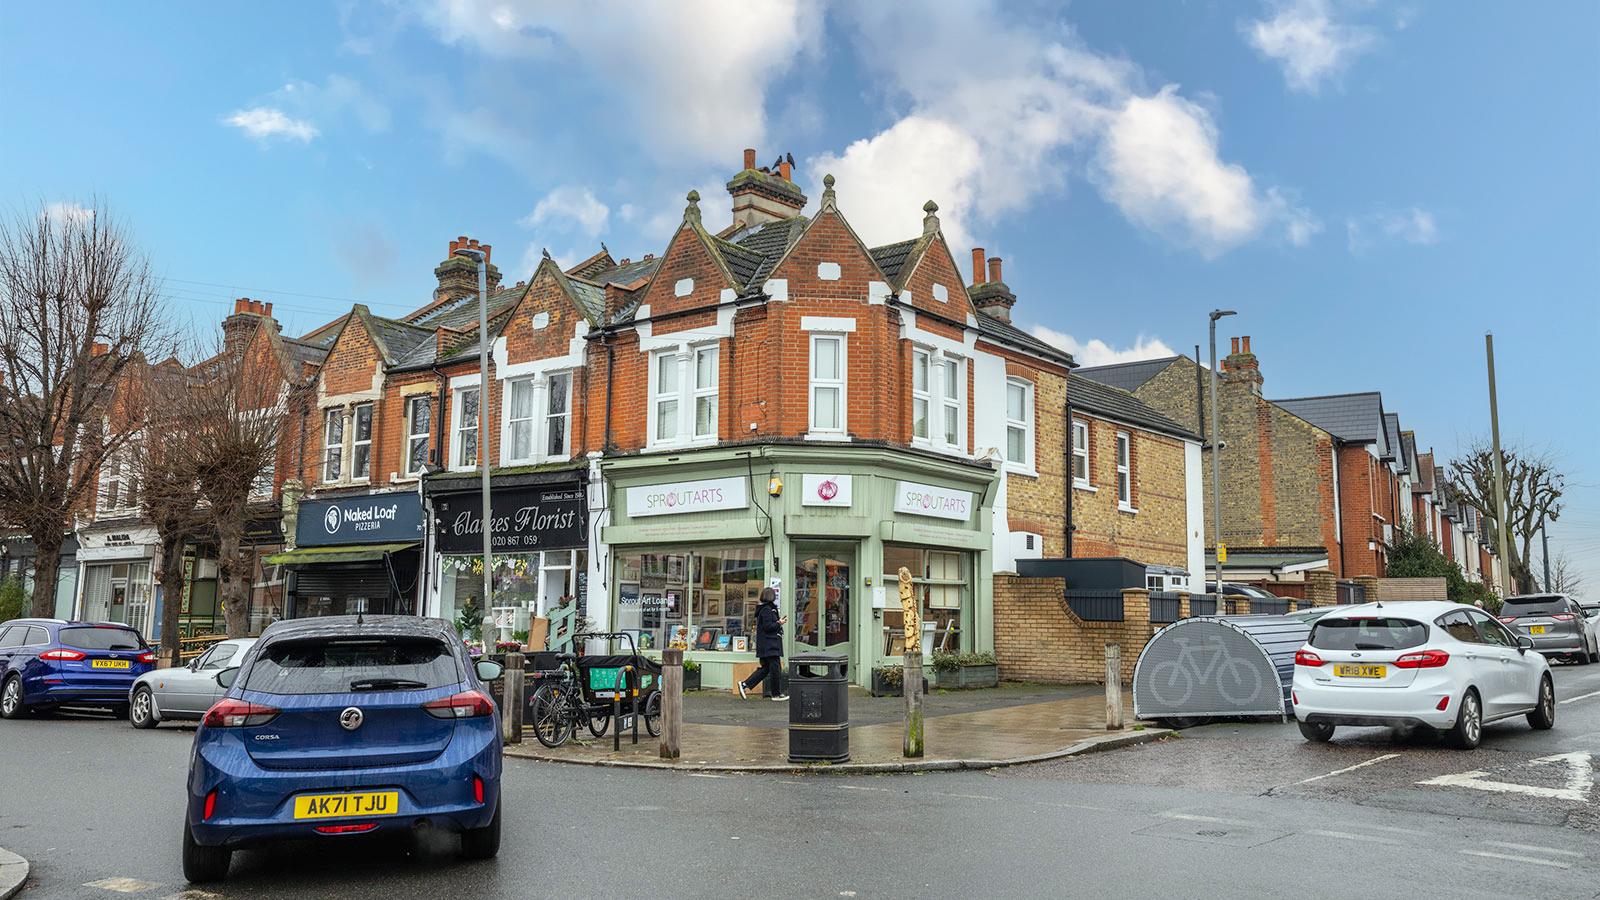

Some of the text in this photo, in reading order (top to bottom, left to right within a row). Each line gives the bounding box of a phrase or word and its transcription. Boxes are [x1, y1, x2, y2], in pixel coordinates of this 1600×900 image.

[646, 488, 723, 508] SPROUTARTS
[906, 491, 966, 513] SPROUTARTS
[343, 504, 398, 522] Naked Loaf
[514, 506, 576, 532] Florist
[354, 521, 381, 532] PIZZERIA
[492, 535, 538, 546] 020 867 059
[641, 596, 651, 605] Art
[1340, 666, 1380, 676] WR18 XWE
[307, 795, 387, 815] AK71 TJU
